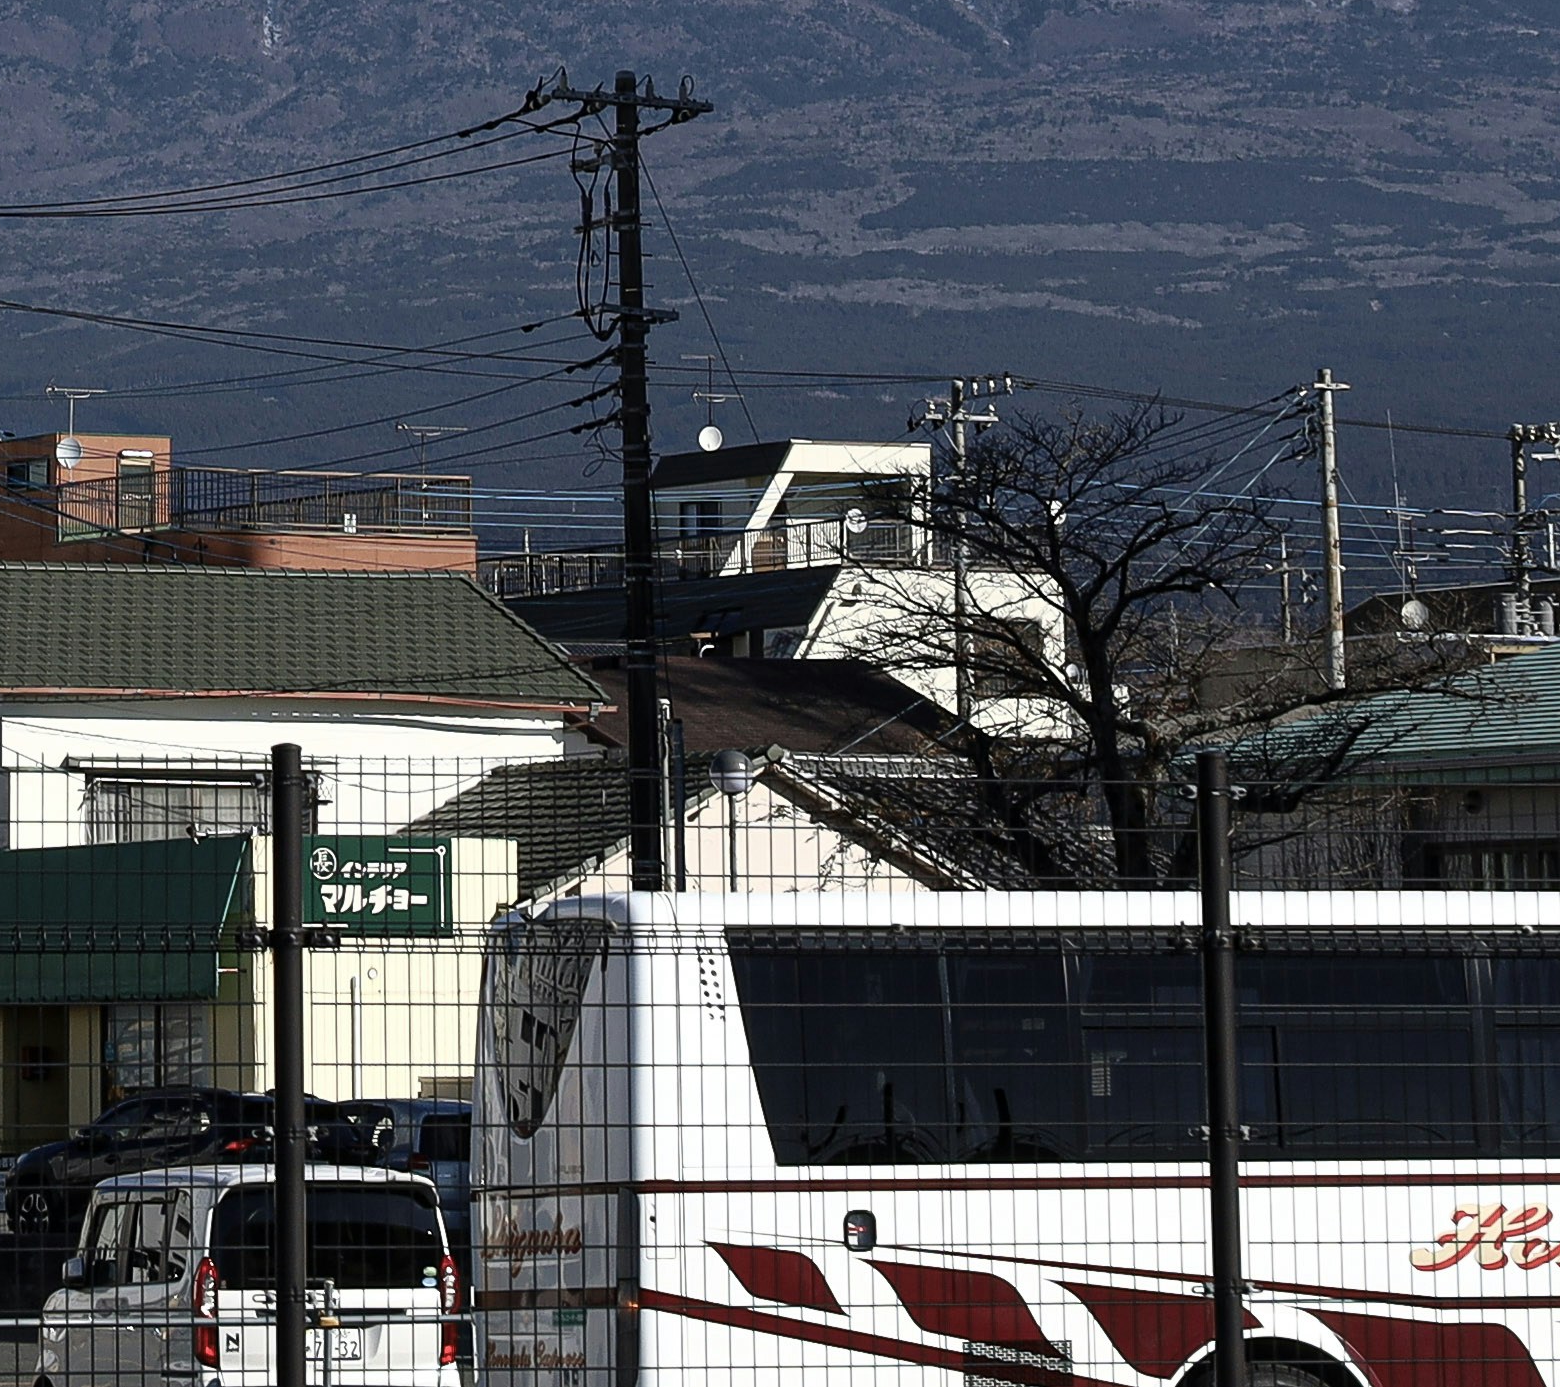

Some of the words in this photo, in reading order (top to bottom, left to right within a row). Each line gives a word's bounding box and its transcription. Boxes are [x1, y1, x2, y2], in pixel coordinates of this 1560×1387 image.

[341, 861, 407, 879] インテリア
[321, 884, 428, 915] マルチョー
